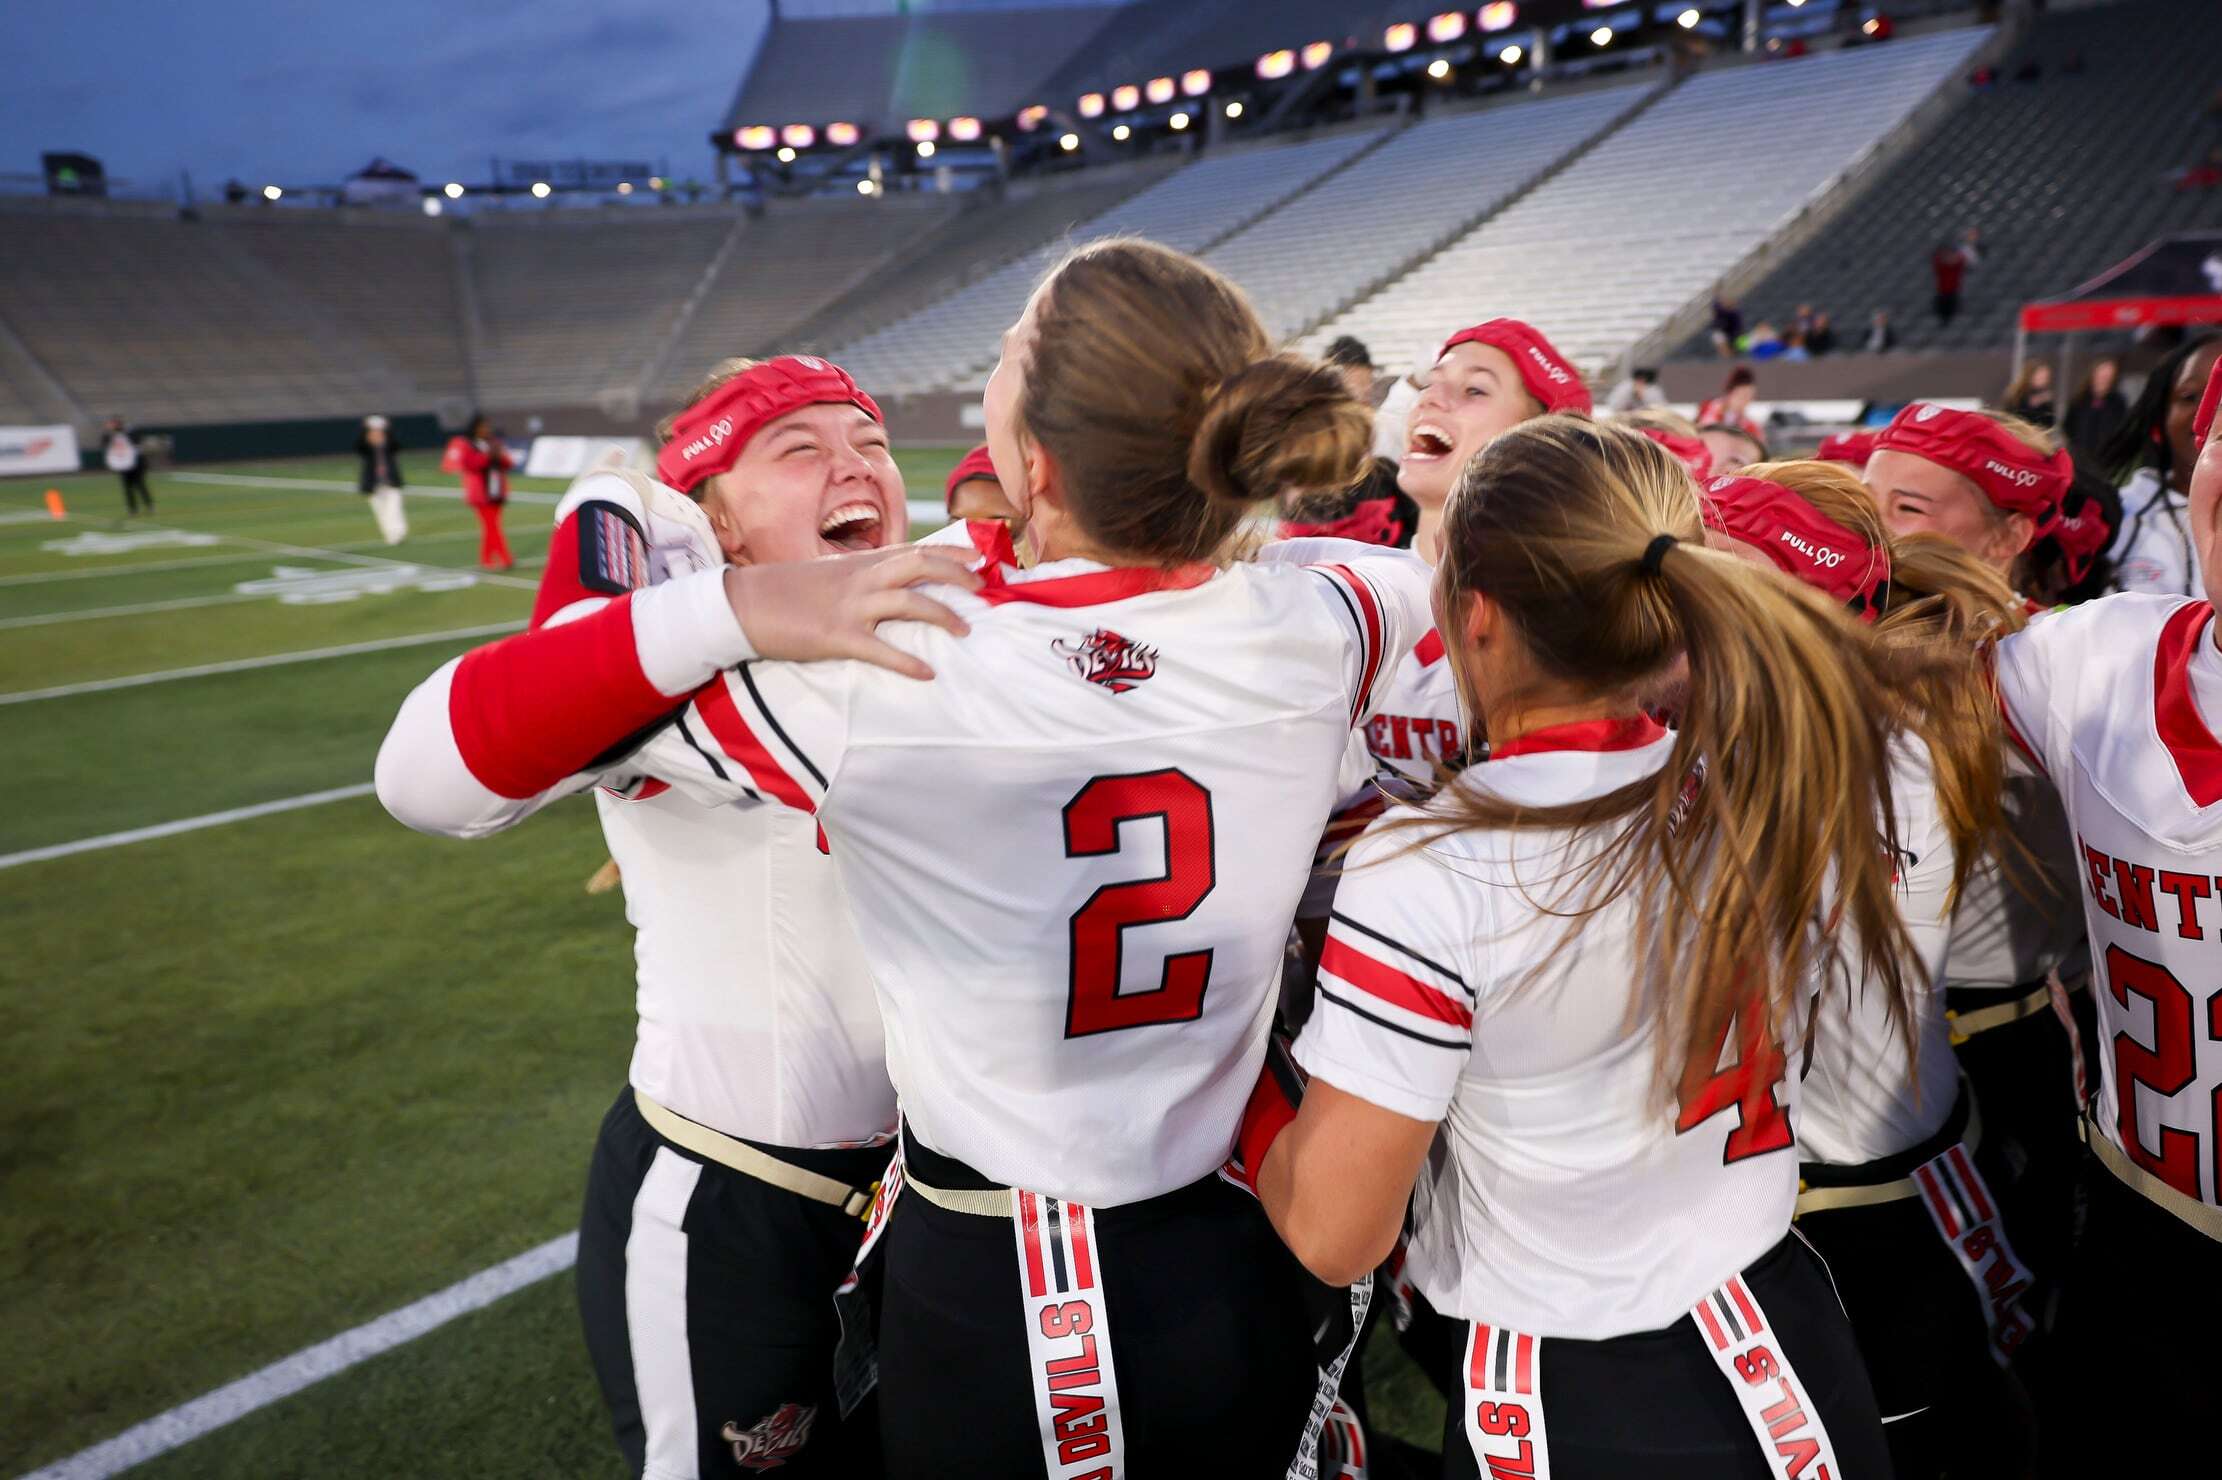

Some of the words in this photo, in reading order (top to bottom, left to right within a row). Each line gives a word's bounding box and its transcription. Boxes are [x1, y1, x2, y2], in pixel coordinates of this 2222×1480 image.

[1050, 633, 1160, 684] DEVILS
[1062, 766, 1217, 1040] 2
[2077, 832, 2222, 942] ENT
[1674, 955, 1796, 1168] 4
[2105, 941, 2222, 1207] 2
[1039, 1299, 1112, 1466] DEVILS
